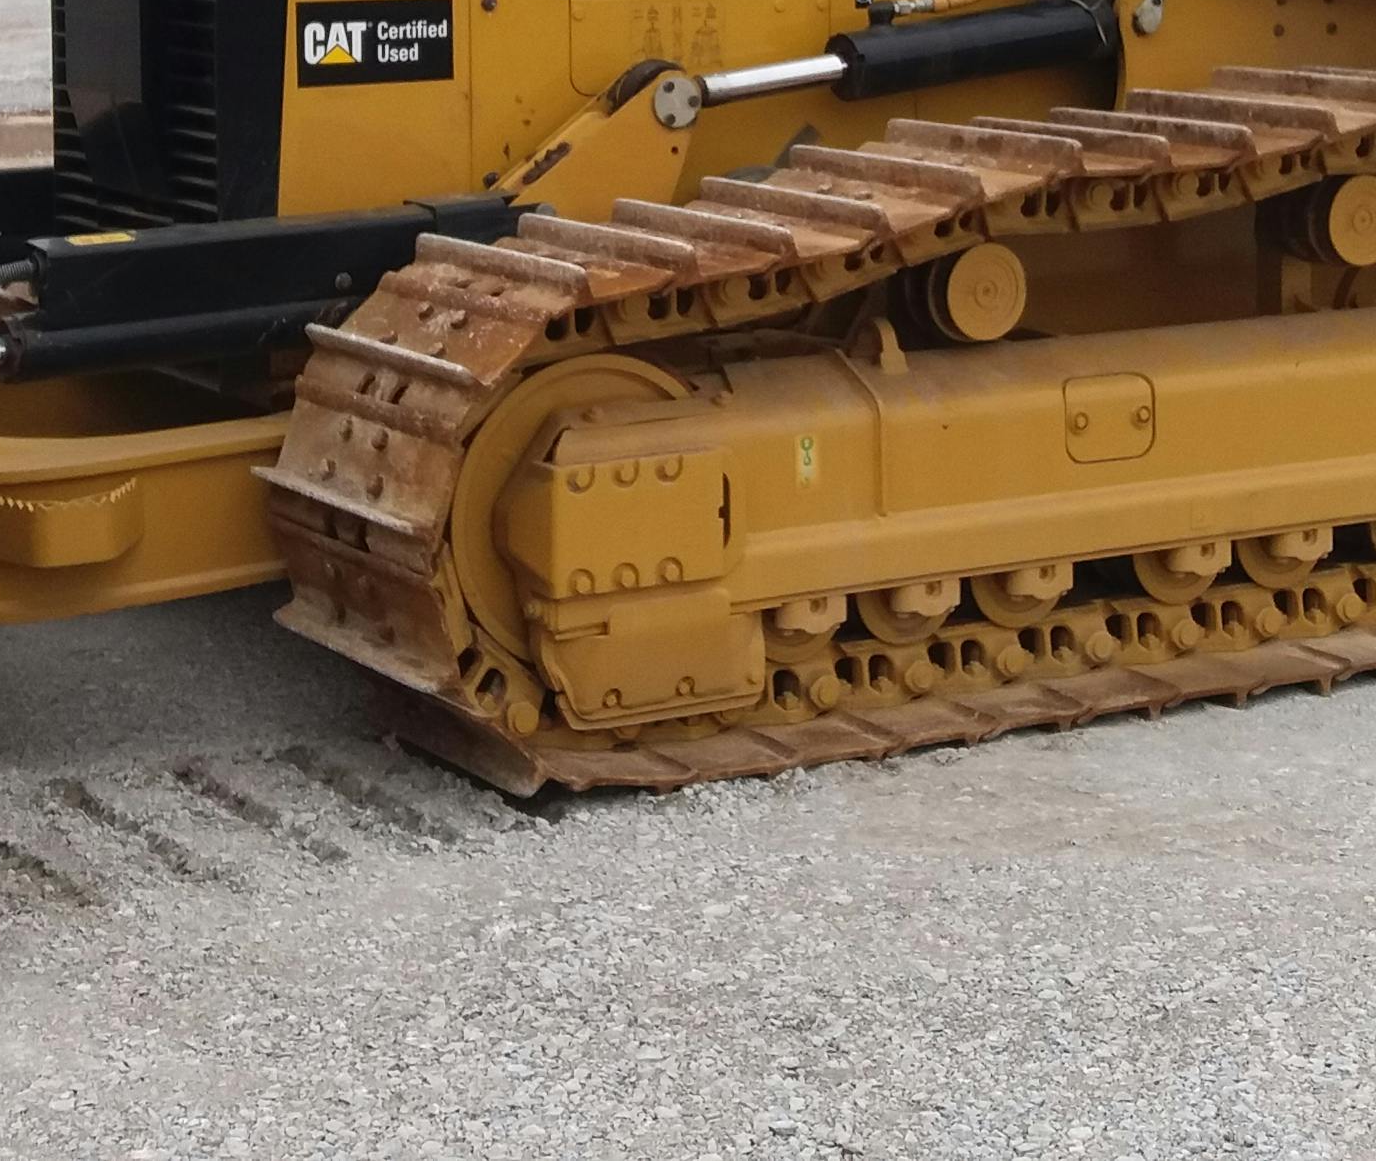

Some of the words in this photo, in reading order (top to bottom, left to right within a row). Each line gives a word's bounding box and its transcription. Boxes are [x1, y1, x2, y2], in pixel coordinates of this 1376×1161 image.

[377, 18, 448, 40] Certified
[303, 21, 367, 65] CAT
[377, 42, 420, 64] Used
